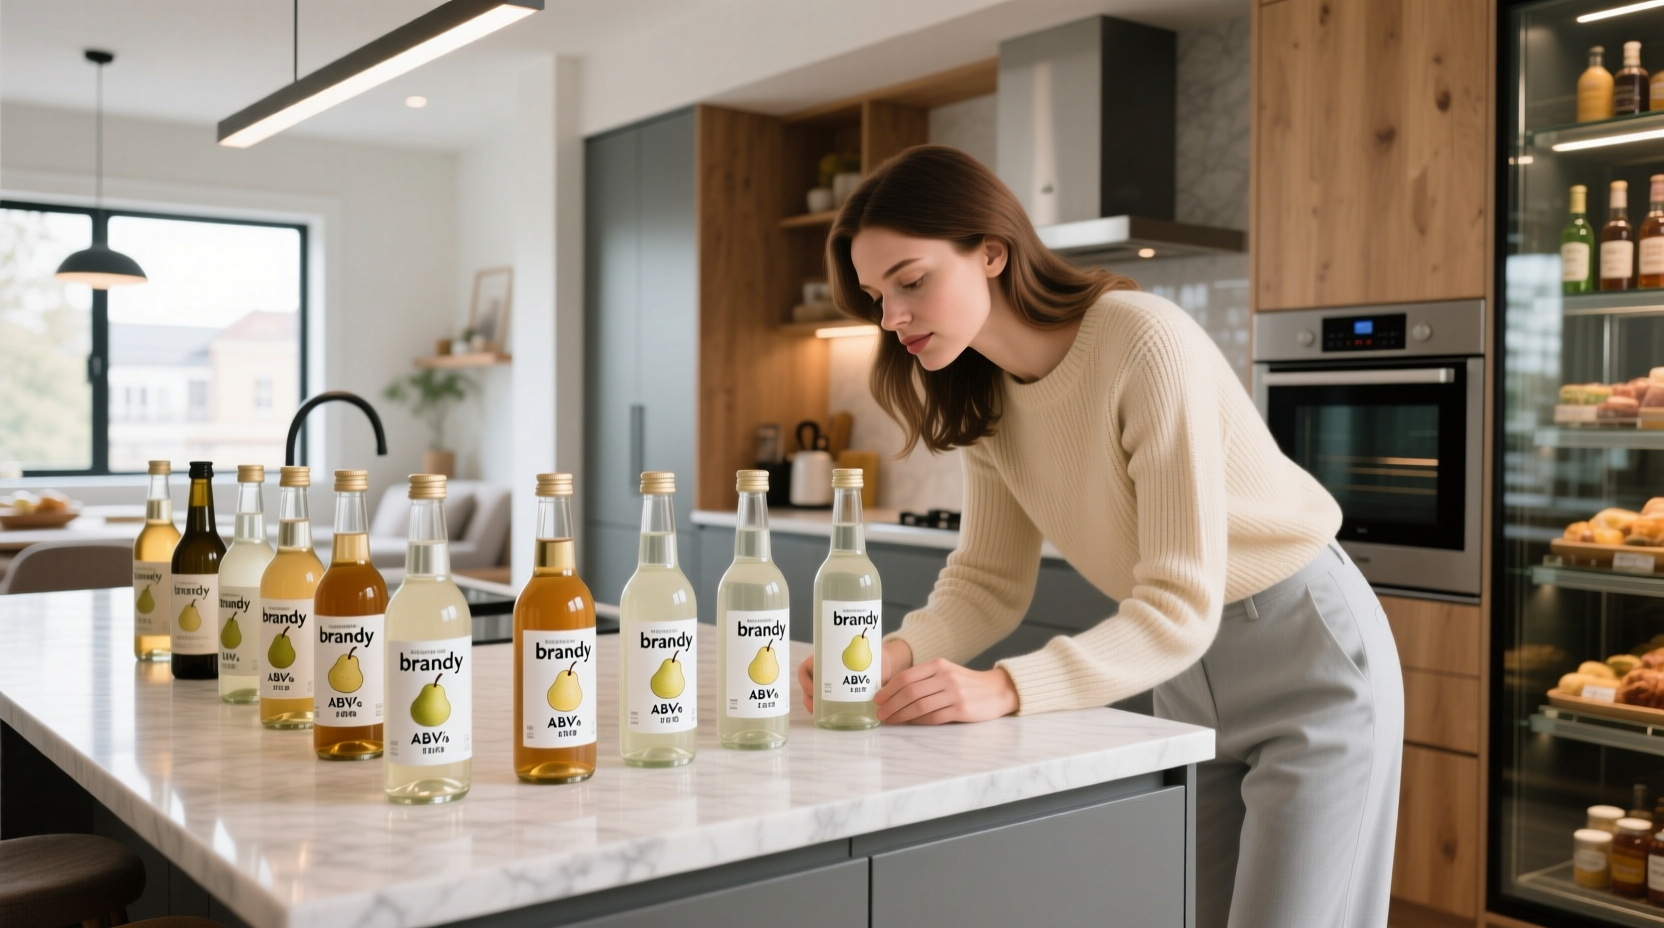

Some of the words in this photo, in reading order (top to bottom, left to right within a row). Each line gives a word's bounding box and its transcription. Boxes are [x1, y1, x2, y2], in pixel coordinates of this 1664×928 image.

[262, 607, 307, 629] brandy
[834, 610, 879, 630] brandy
[320, 626, 374, 648] brandy
[737, 619, 786, 641] brandy
[535, 640, 591, 662] brandy
[640, 631, 693, 652] brandy
[399, 651, 463, 674] brandy
